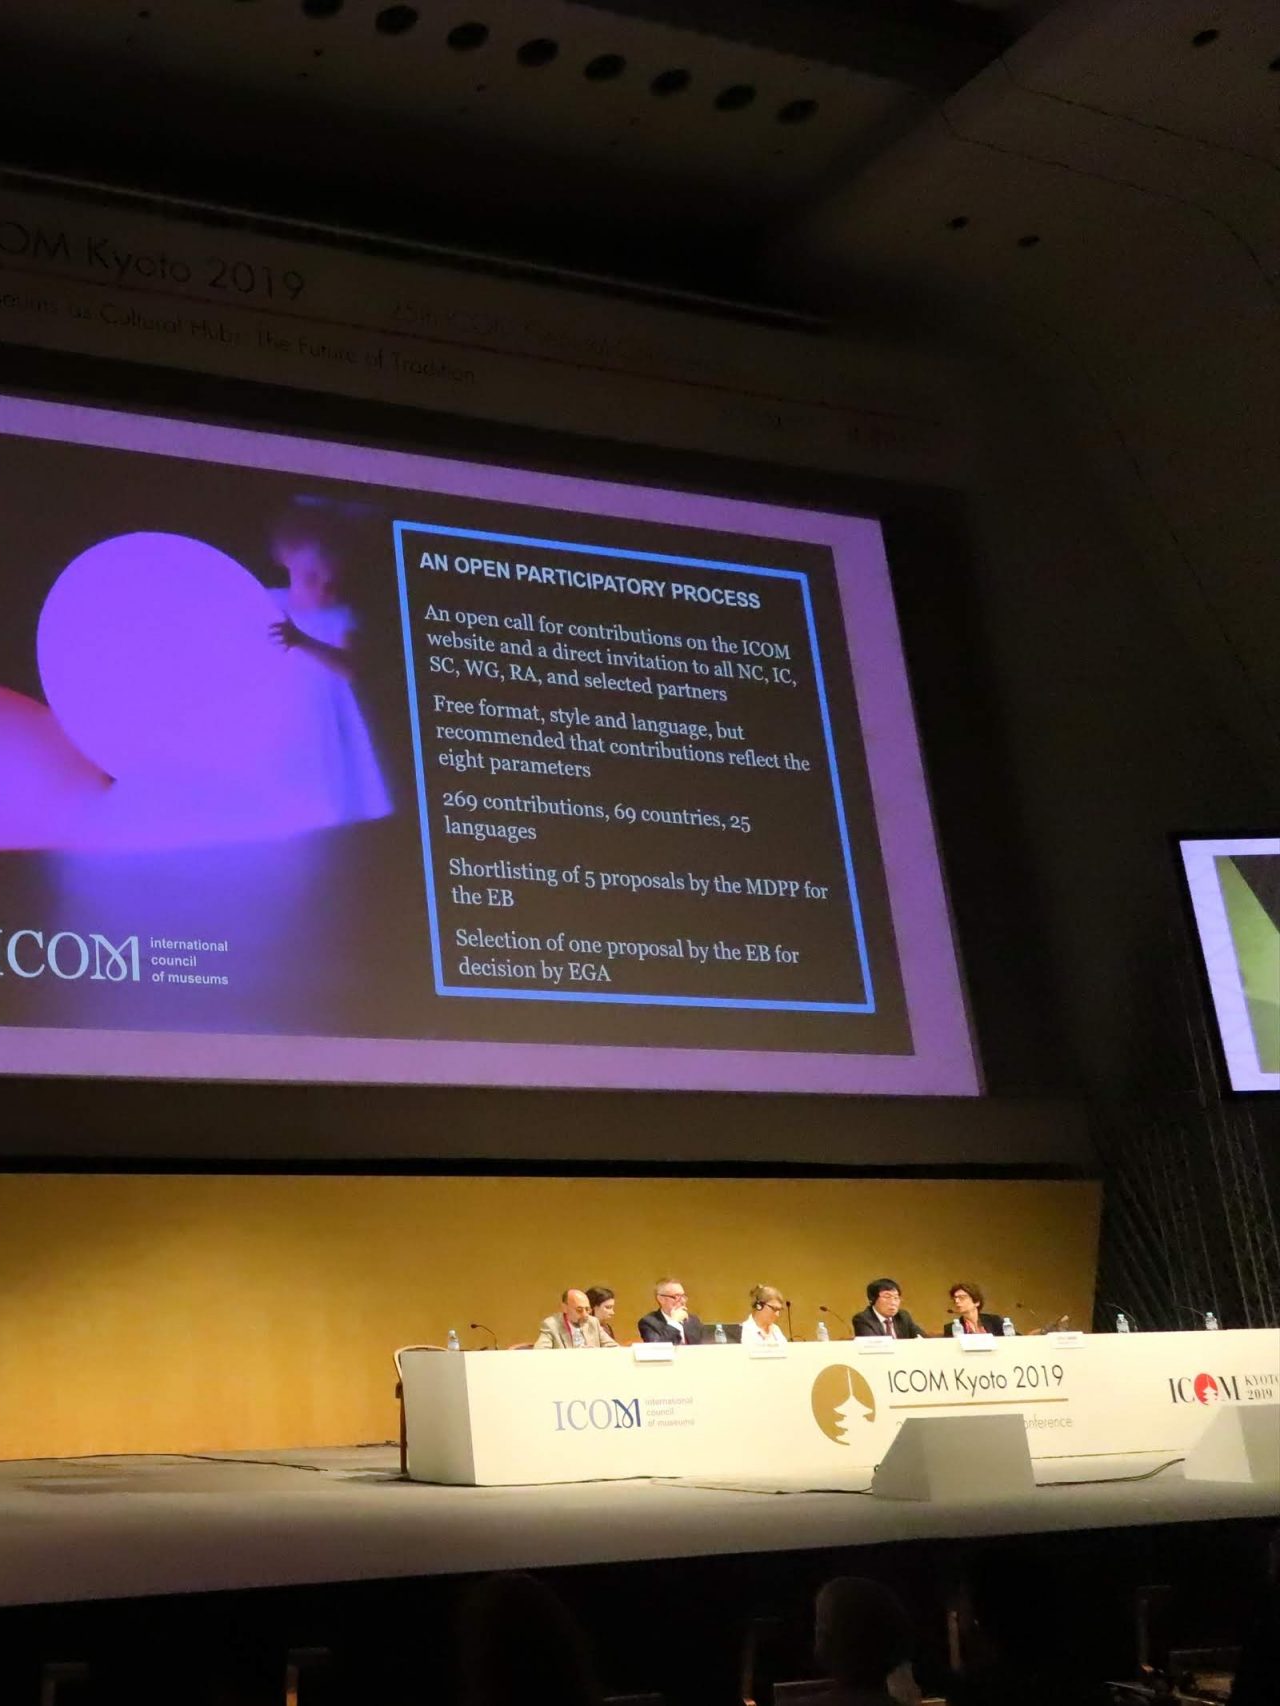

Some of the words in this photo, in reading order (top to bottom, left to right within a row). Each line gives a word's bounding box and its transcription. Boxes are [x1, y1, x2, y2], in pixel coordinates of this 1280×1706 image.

[87, 236, 191, 283] Kyoto
[208, 256, 305, 301] 2019
[420, 552, 448, 571] AN
[454, 556, 510, 579] OPEN
[516, 563, 666, 598] PARTICIPATORY
[671, 583, 761, 609] PROCESS
[424, 604, 450, 622] An
[455, 610, 499, 628] open
[504, 613, 534, 631] call
[539, 616, 563, 635] for
[568, 622, 682, 648] contributions
[687, 637, 708, 651] on
[712, 635, 738, 654] the
[742, 640, 791, 660] ICOM
[426, 631, 495, 652] website
[500, 639, 533, 656] and
[538, 646, 548, 658] a
[552, 643, 603, 664] direct
[607, 649, 688, 673] invitation
[692, 660, 709, 675] to
[714, 661, 733, 678] all
[737, 664, 769, 684] NC,
[773, 668, 797, 687] IC,
[430, 656, 460, 678] SC,
[464, 659, 505, 682] WG,
[510, 664, 542, 685] RA,
[547, 669, 579, 687] and
[584, 672, 652, 694] selected
[657, 681, 728, 701] partners
[433, 695, 474, 714] Free
[479, 698, 545, 725] format,
[550, 707, 591, 728] style
[595, 712, 627, 730] and
[631, 713, 713, 739] language,
[716, 721, 745, 740] but
[436, 725, 565, 750] recommended
[570, 733, 606, 753] that
[609, 740, 725, 764] contributions
[729, 749, 780, 769] reflect
[784, 753, 810, 771] the
[439, 749, 485, 771] eight
[489, 755, 592, 777] parameters
[443, 790, 477, 811] 269
[483, 795, 610, 822] contributions,
[614, 803, 636, 824] 69
[641, 809, 726, 831] countries,
[730, 815, 751, 833] 25
[445, 815, 537, 843] languages
[449, 857, 559, 887] Shortlisting
[562, 865, 580, 883] of
[585, 871, 595, 888] 5
[599, 871, 685, 892] proposals
[688, 872, 710, 896] by
[713, 875, 742, 894] the
[745, 878, 800, 897] MDPP
[804, 881, 828, 899] for
[451, 885, 482, 905] the
[486, 888, 514, 907] EB
[150, 936, 228, 952] international
[456, 928, 541, 950] Selection
[546, 932, 565, 951] of
[569, 940, 602, 953] one
[607, 938, 683, 960] proposal
[686, 940, 709, 964] by
[713, 941, 742, 960] the
[745, 944, 771, 962] EB
[775, 945, 800, 964] for
[151, 954, 197, 968] council
[459, 956, 536, 979] decision
[540, 960, 564, 984] by
[568, 962, 612, 982] EGA
[152, 971, 165, 983] of
[168, 973, 229, 985] museums
[888, 1369, 948, 1393] ICOM
[954, 1368, 1008, 1397] Kyoto
[1013, 1364, 1064, 1389] 2019
[1169, 1373, 1240, 1405] ICOM
[1248, 1388, 1272, 1400] 2019
[552, 1398, 641, 1431] ICOM
[645, 1396, 693, 1406] international
[646, 1408, 674, 1416] council
[1024, 1413, 1072, 1429] onference
